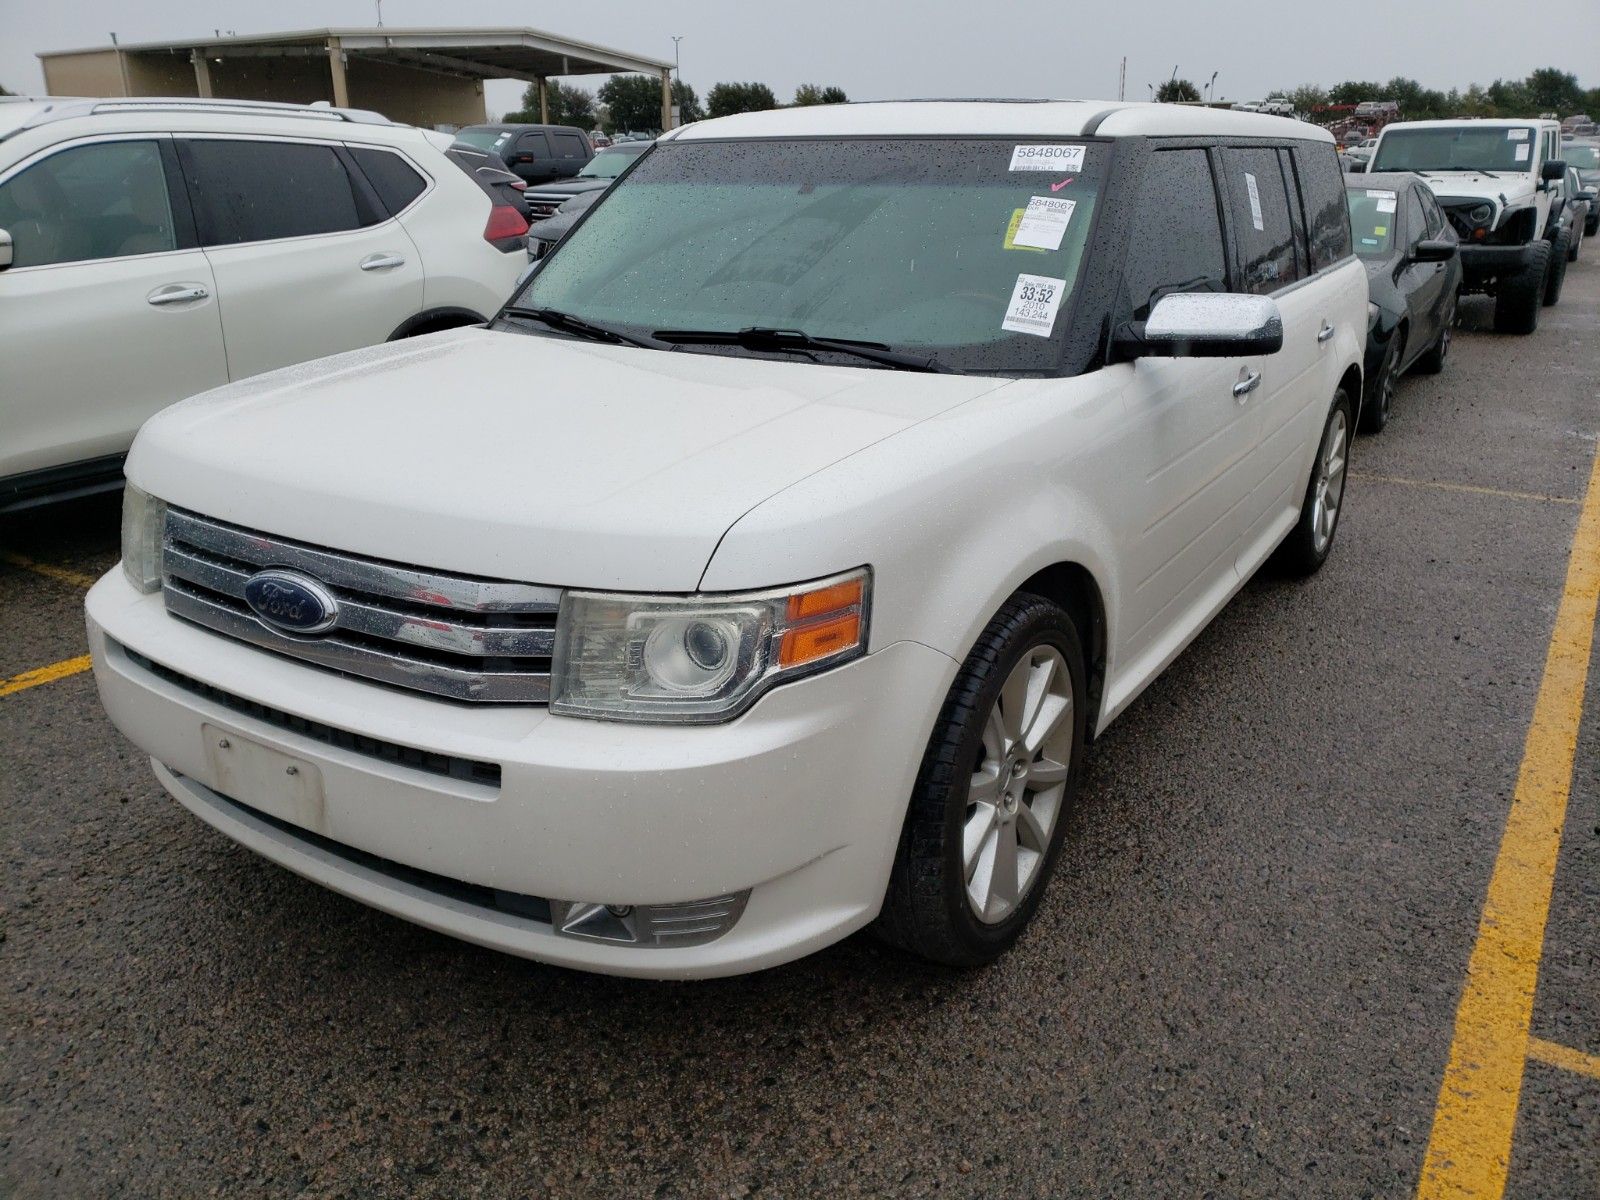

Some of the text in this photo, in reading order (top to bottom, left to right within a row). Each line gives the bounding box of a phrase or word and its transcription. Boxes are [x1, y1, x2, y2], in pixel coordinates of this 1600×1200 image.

[1017, 147, 1082, 158] 5848067
[1028, 198, 1075, 210] 5848067
[1023, 300, 1045, 310] 2010
[257, 581, 307, 619] Ford
